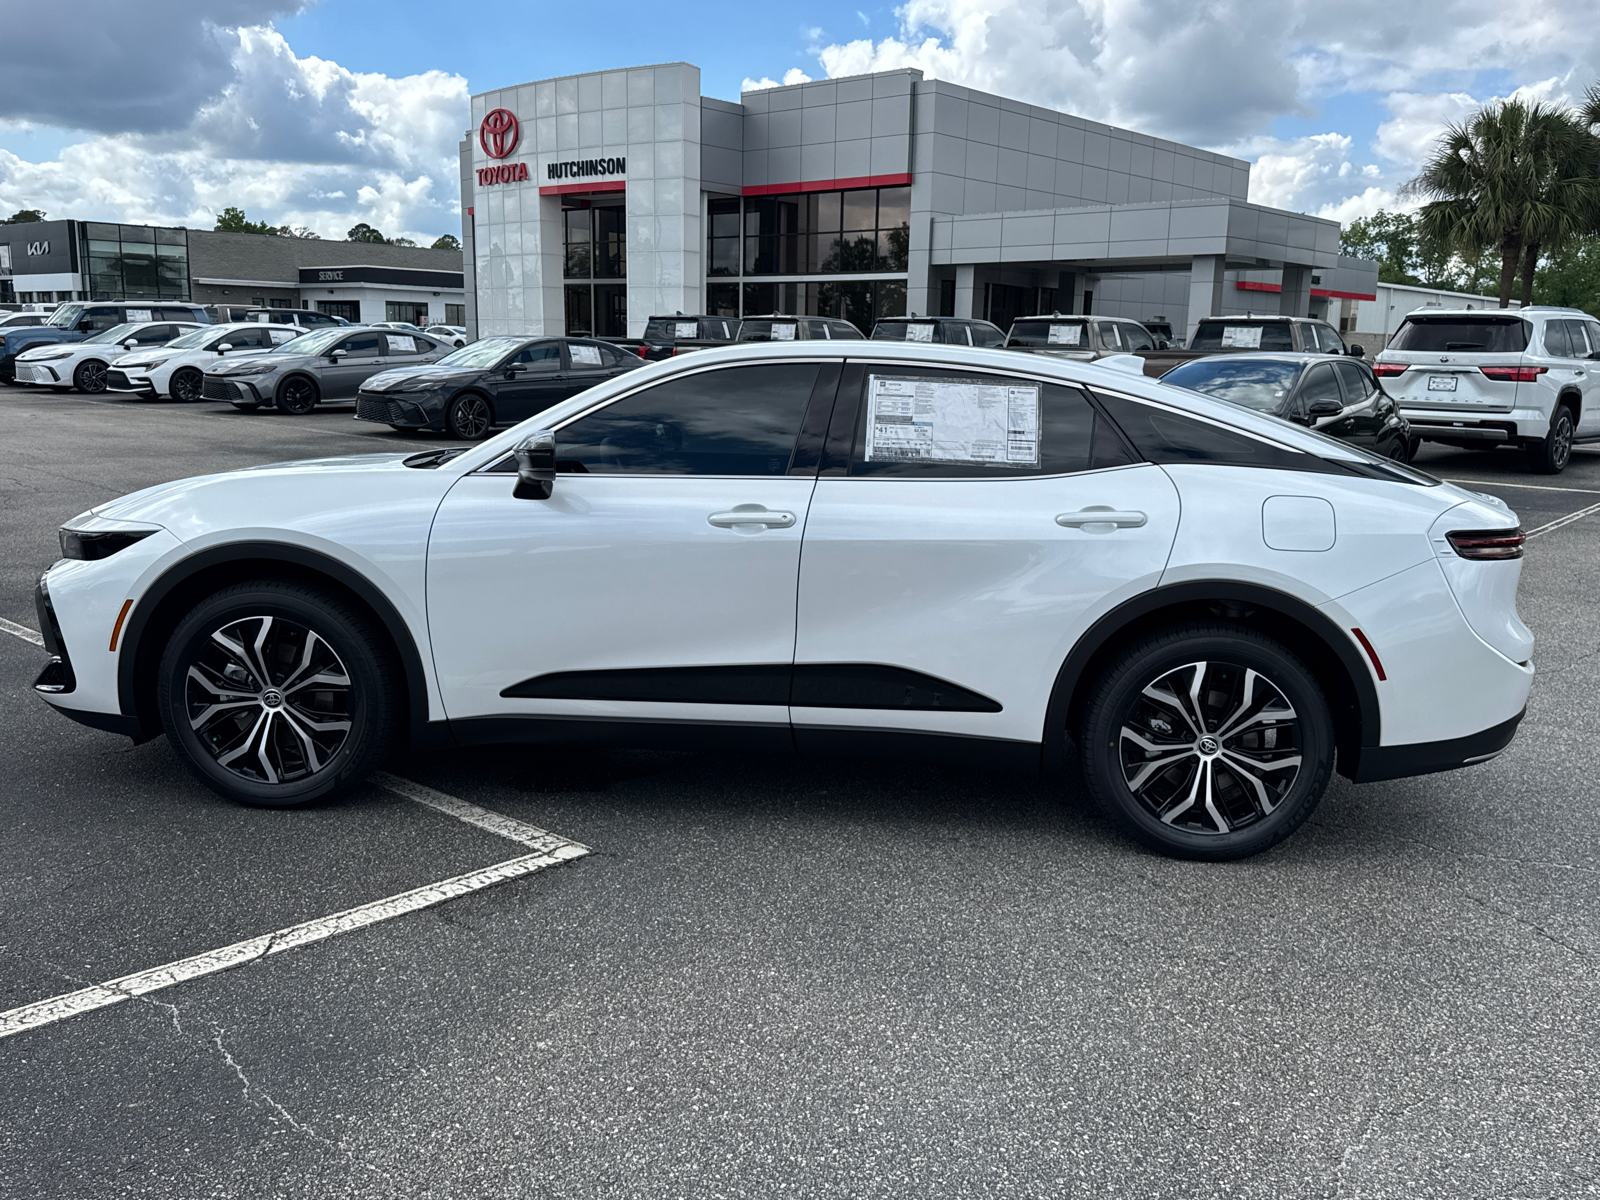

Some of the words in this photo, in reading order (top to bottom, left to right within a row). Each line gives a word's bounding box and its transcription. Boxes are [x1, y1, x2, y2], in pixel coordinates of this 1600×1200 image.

[476, 163, 528, 186] TOYOTA
[547, 157, 626, 179] HUTCHINSON
[27, 241, 50, 256] KIA
[318, 271, 344, 281] SERVICE
[1278, 767, 1325, 837] ECOPIA
